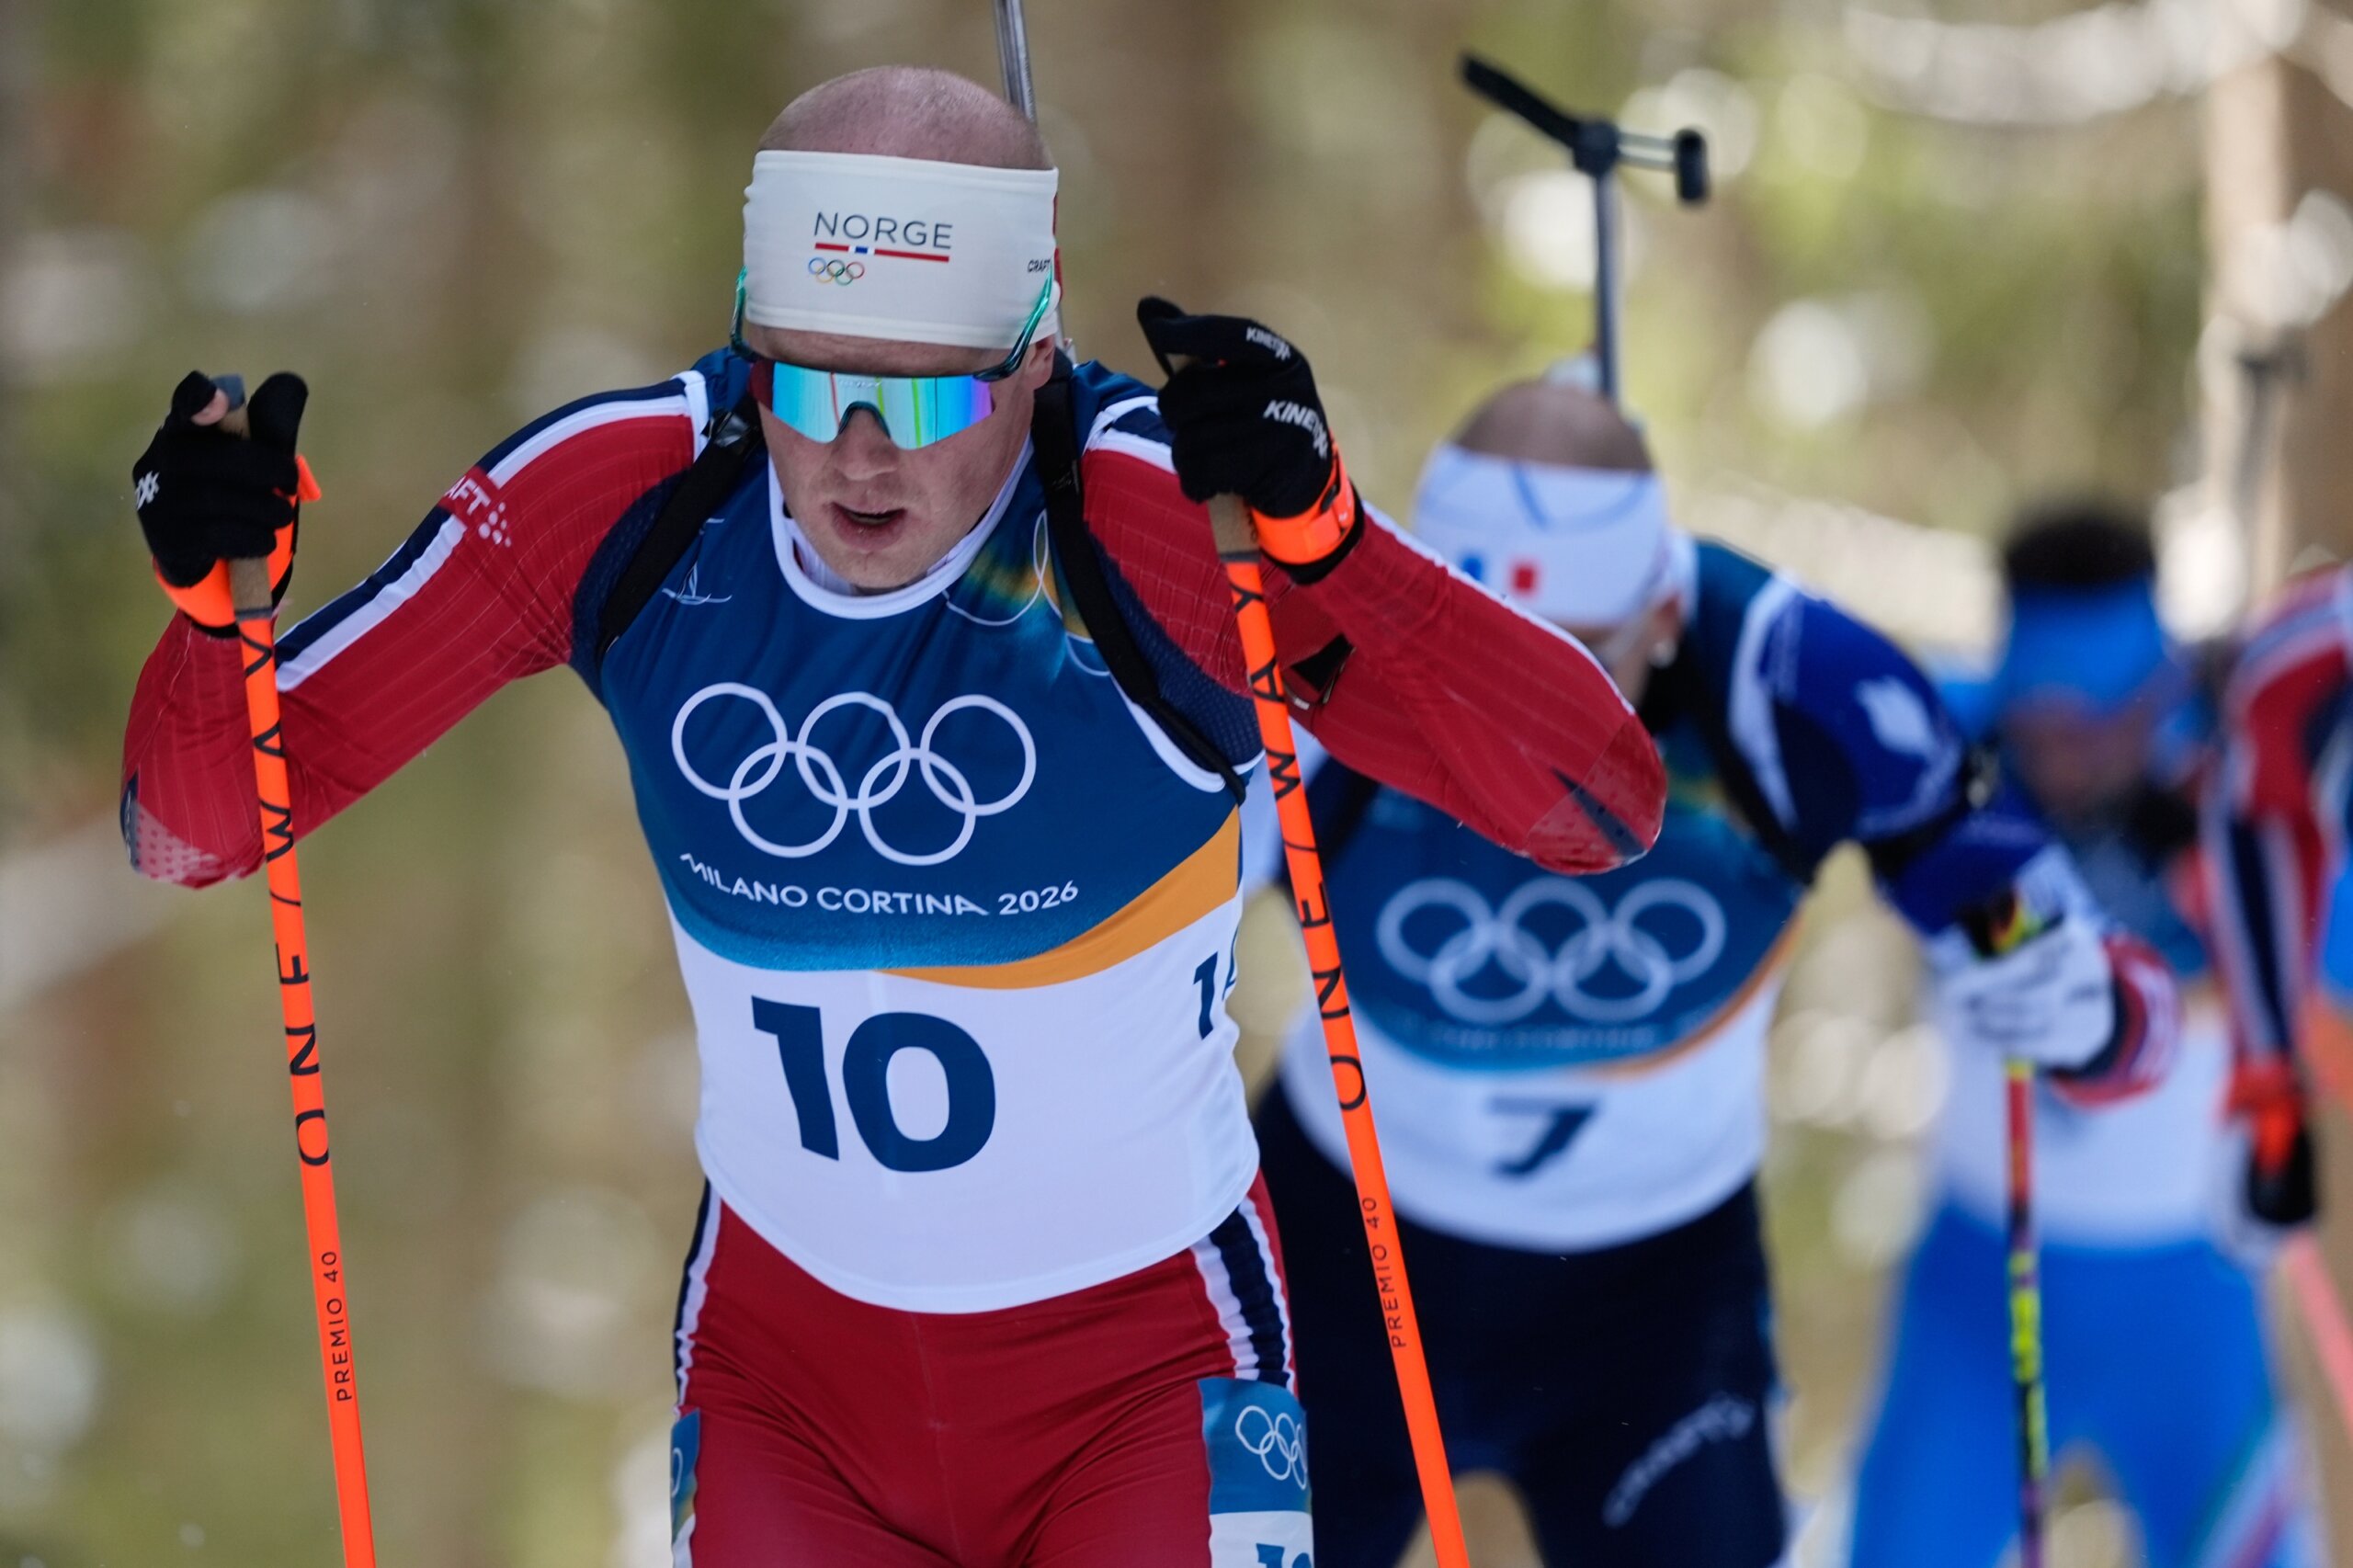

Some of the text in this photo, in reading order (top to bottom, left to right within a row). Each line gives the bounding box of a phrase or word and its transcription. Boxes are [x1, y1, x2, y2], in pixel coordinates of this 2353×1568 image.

[813, 211, 953, 249] NORGE
[1027, 258, 1051, 273] CRAFT
[679, 853, 1079, 915] MILANO CORTINA 2026
[751, 994, 995, 1172] 10
[1486, 1096, 1603, 1178] 7
[1361, 1197, 1407, 1348] PREMIO 40
[321, 1251, 352, 1402] PREMIO 40
